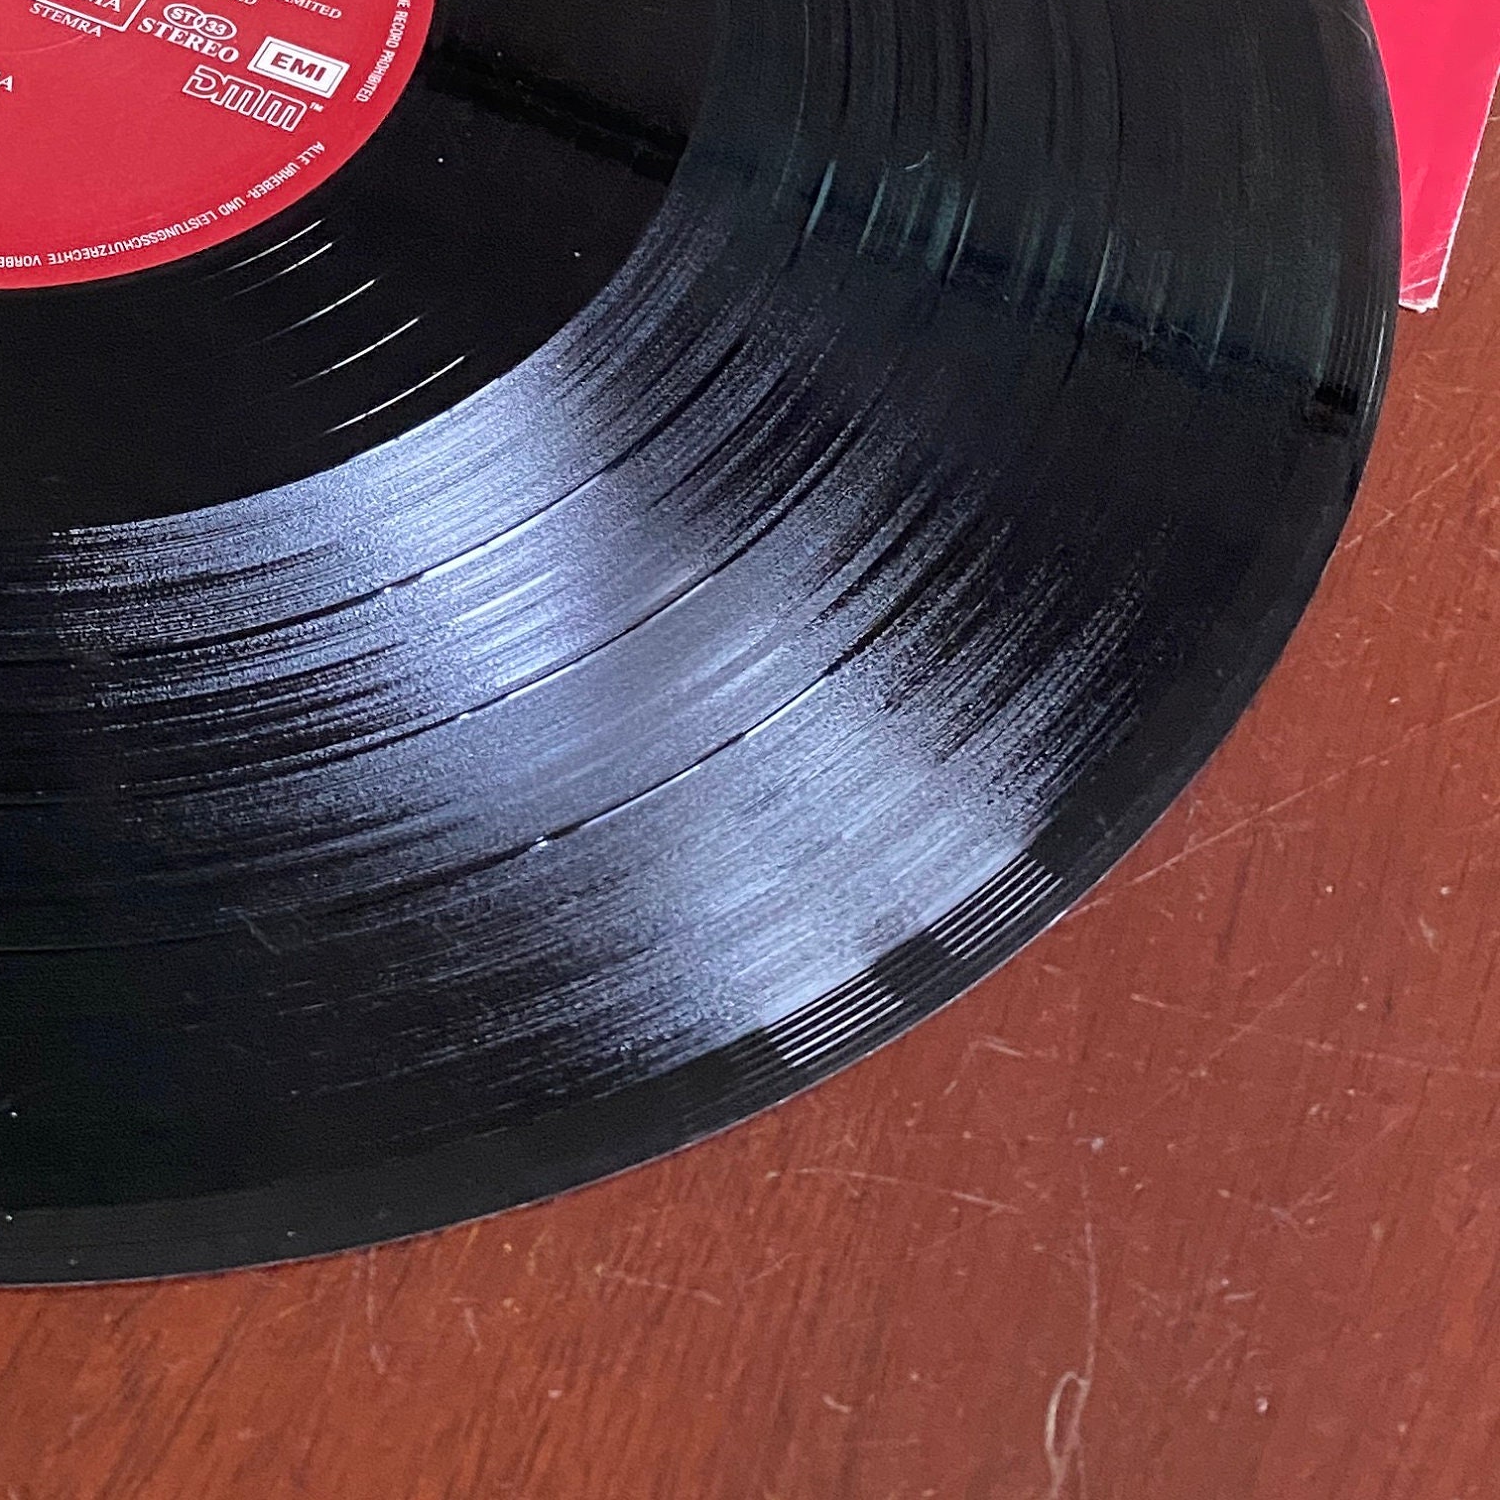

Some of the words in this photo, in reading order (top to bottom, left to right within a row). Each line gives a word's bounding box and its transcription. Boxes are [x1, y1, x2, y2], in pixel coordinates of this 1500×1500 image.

[29, 3, 101, 37] STEMRA
[204, 19, 227, 35] 33
[386, 11, 408, 48] RECORD
[137, 17, 239, 62] STEREO
[270, 52, 327, 81] EMI
[296, 141, 325, 165] ALLE
[218, 197, 246, 216] UND
[47, 210, 218, 264] LEISTUNGSSCHUTZRECHTE
